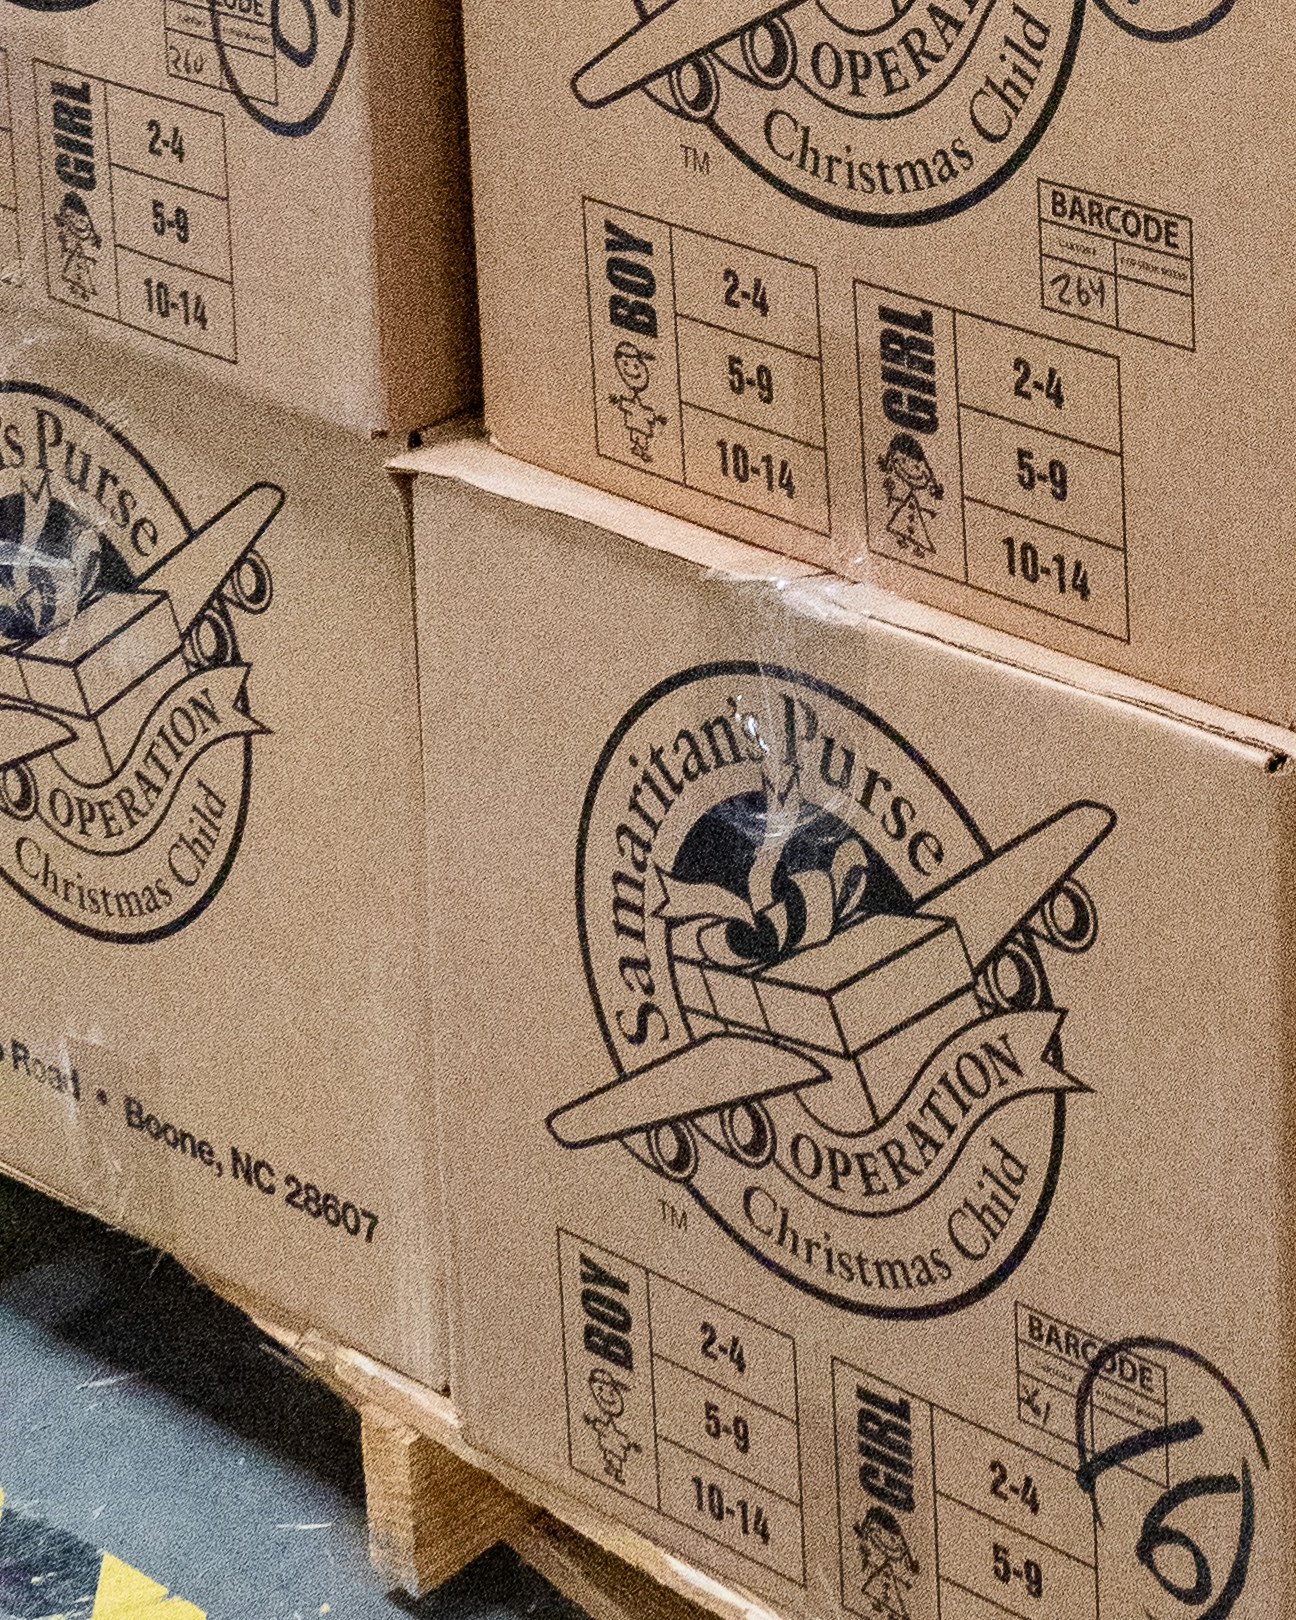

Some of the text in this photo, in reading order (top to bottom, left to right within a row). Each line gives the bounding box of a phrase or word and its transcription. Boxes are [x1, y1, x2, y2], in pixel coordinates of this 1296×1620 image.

[763, 2, 1051, 196] Christmas Child
[51, 81, 97, 192] GIRL
[146, 118, 185, 164] 2-4
[151, 199, 190, 245] 5-9
[1050, 190, 1180, 250] BARCODE
[143, 276, 208, 332] 10-14
[604, 220, 660, 338] BOY
[723, 269, 768, 317] 2-4
[728, 355, 774, 404] 5-9
[878, 305, 940, 435] GIRL
[1012, 358, 1065, 409] 2-4
[35, 407, 161, 558] Purse
[717, 439, 796, 499] 10-14
[1016, 449, 1068, 502] 5-9
[1002, 536, 1091, 601] 10-14
[48, 687, 223, 842] OPERATION
[780, 692, 945, 877] Purse
[14, 783, 227, 922] Christmas Child
[790, 1032, 1025, 1197] OPERATION
[124, 1097, 223, 1175] Boone,
[230, 1149, 278, 1198] NC
[284, 1172, 380, 1244] 28607
[743, 1139, 1030, 1291] Christmas Child
[579, 1254, 634, 1370] BOY
[699, 1321, 747, 1374] 2-4
[1026, 1313, 1156, 1392] BARCODE
[704, 1400, 750, 1453] 5-9
[855, 1385, 917, 1514] GIRL
[691, 1477, 770, 1545] 10-14
[989, 1460, 1040, 1515] 2-4
[992, 1542, 1043, 1598] 5-9
